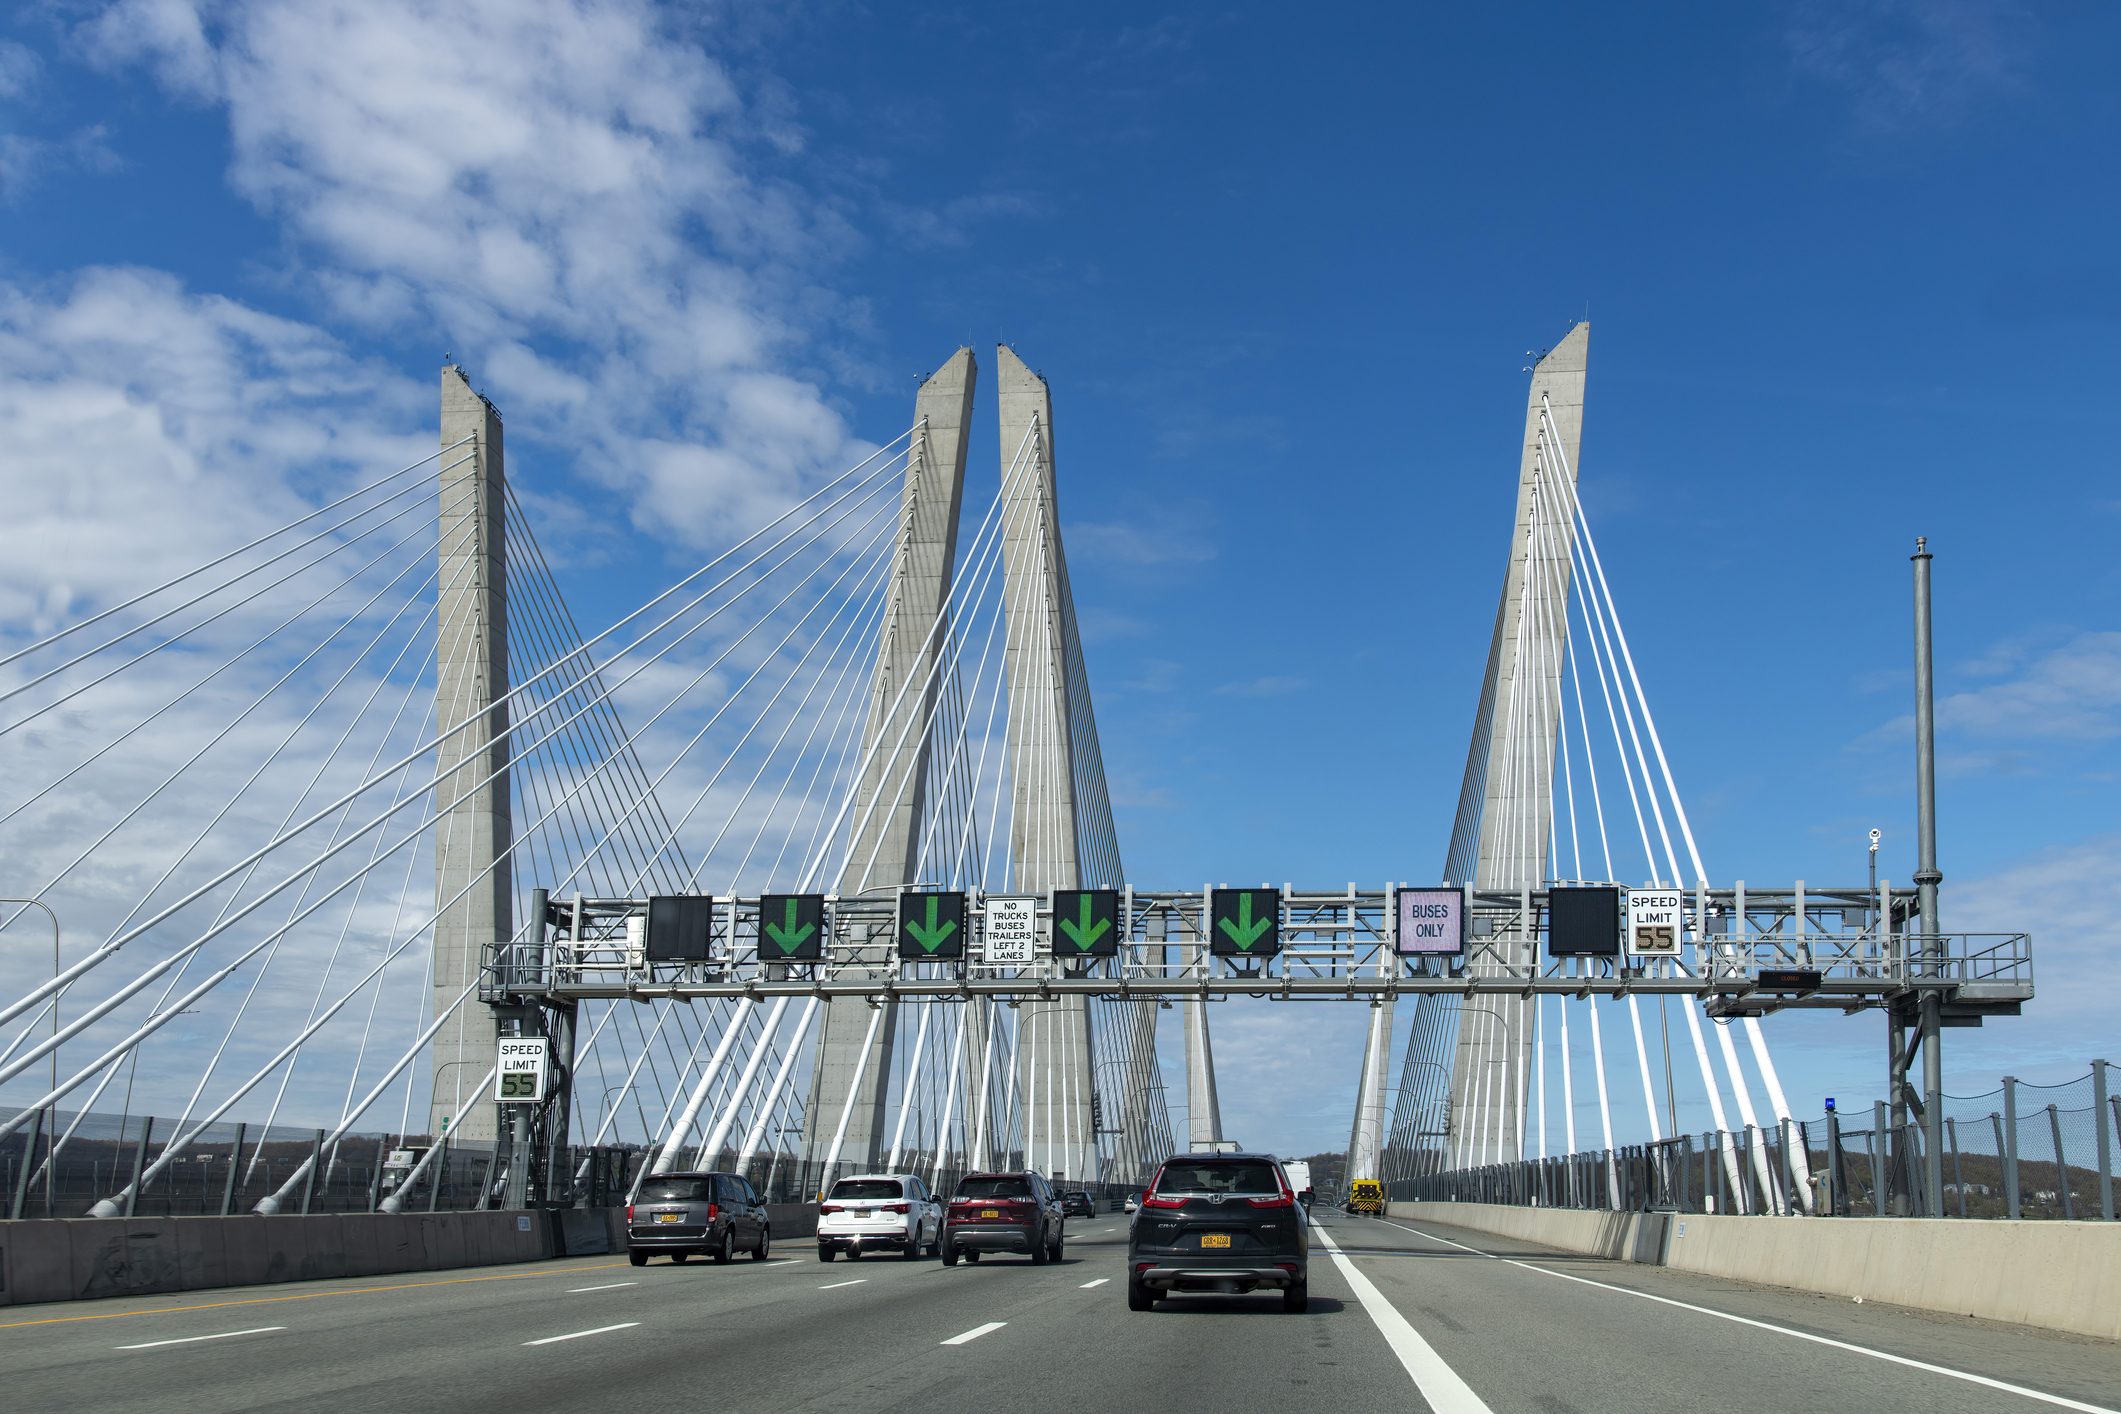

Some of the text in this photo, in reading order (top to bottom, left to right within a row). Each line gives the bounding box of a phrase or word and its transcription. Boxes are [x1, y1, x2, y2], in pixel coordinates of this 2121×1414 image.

[1004, 902, 1017, 910] NO
[1631, 897, 1678, 908] SPEED
[992, 912, 1028, 920] TRUCKS
[1412, 904, 1448, 918] BUSES
[1636, 912, 1673, 923] LIMIT
[995, 922, 1025, 930] BUSES
[1416, 923, 1445, 937] ONLY
[988, 932, 1031, 940] TRAILERS
[1637, 927, 1673, 949] 55
[994, 941, 1025, 950] LEFT 2
[994, 951, 1024, 960] LANES
[501, 1045, 543, 1055] SPEED
[504, 1060, 537, 1070] LIMIT
[502, 1074, 535, 1095] 55
